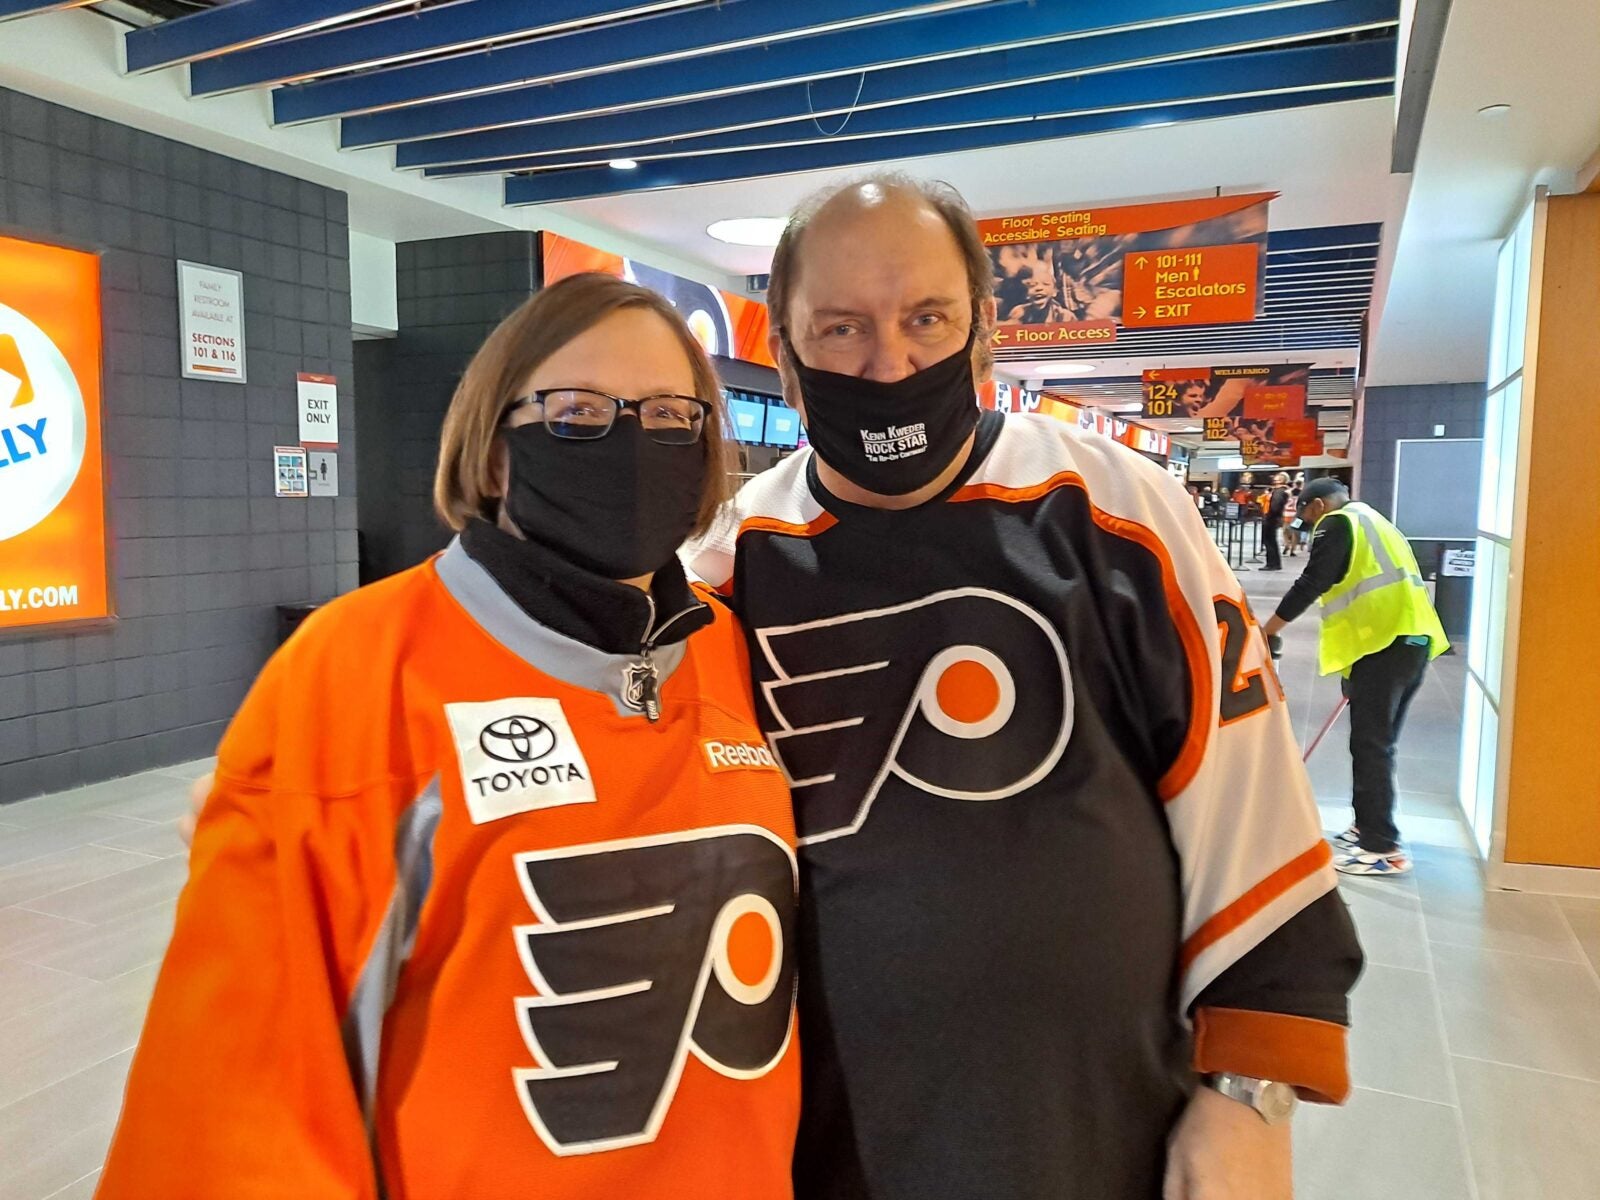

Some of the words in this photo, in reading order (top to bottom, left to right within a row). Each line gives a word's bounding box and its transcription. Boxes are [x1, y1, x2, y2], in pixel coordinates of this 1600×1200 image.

[1002, 216, 1034, 229] Floor
[1041, 211, 1091, 226] Seating
[984, 227, 1050, 244] Accessible
[1057, 222, 1107, 237] Seating
[1156, 253, 1202, 269] 101-111
[1156, 270, 1188, 284] Men
[1155, 283, 1246, 300] Escalators
[1155, 304, 1192, 319] EXIT
[192, 333, 235, 348] SECTIONS
[1016, 328, 1054, 342] Floor
[1058, 326, 1111, 341] Access
[193, 346, 208, 358] 101
[211, 348, 219, 360] &
[222, 350, 236, 362] 116
[1148, 384, 1178, 400] 124
[308, 399, 329, 410] EXIT
[1147, 400, 1173, 416] 101
[306, 412, 331, 424] ONLY
[1205, 429, 1228, 439] 102
[863, 442, 896, 455] ROCK
[897, 433, 928, 451] STAR
[472, 762, 586, 797] TOYOTA
